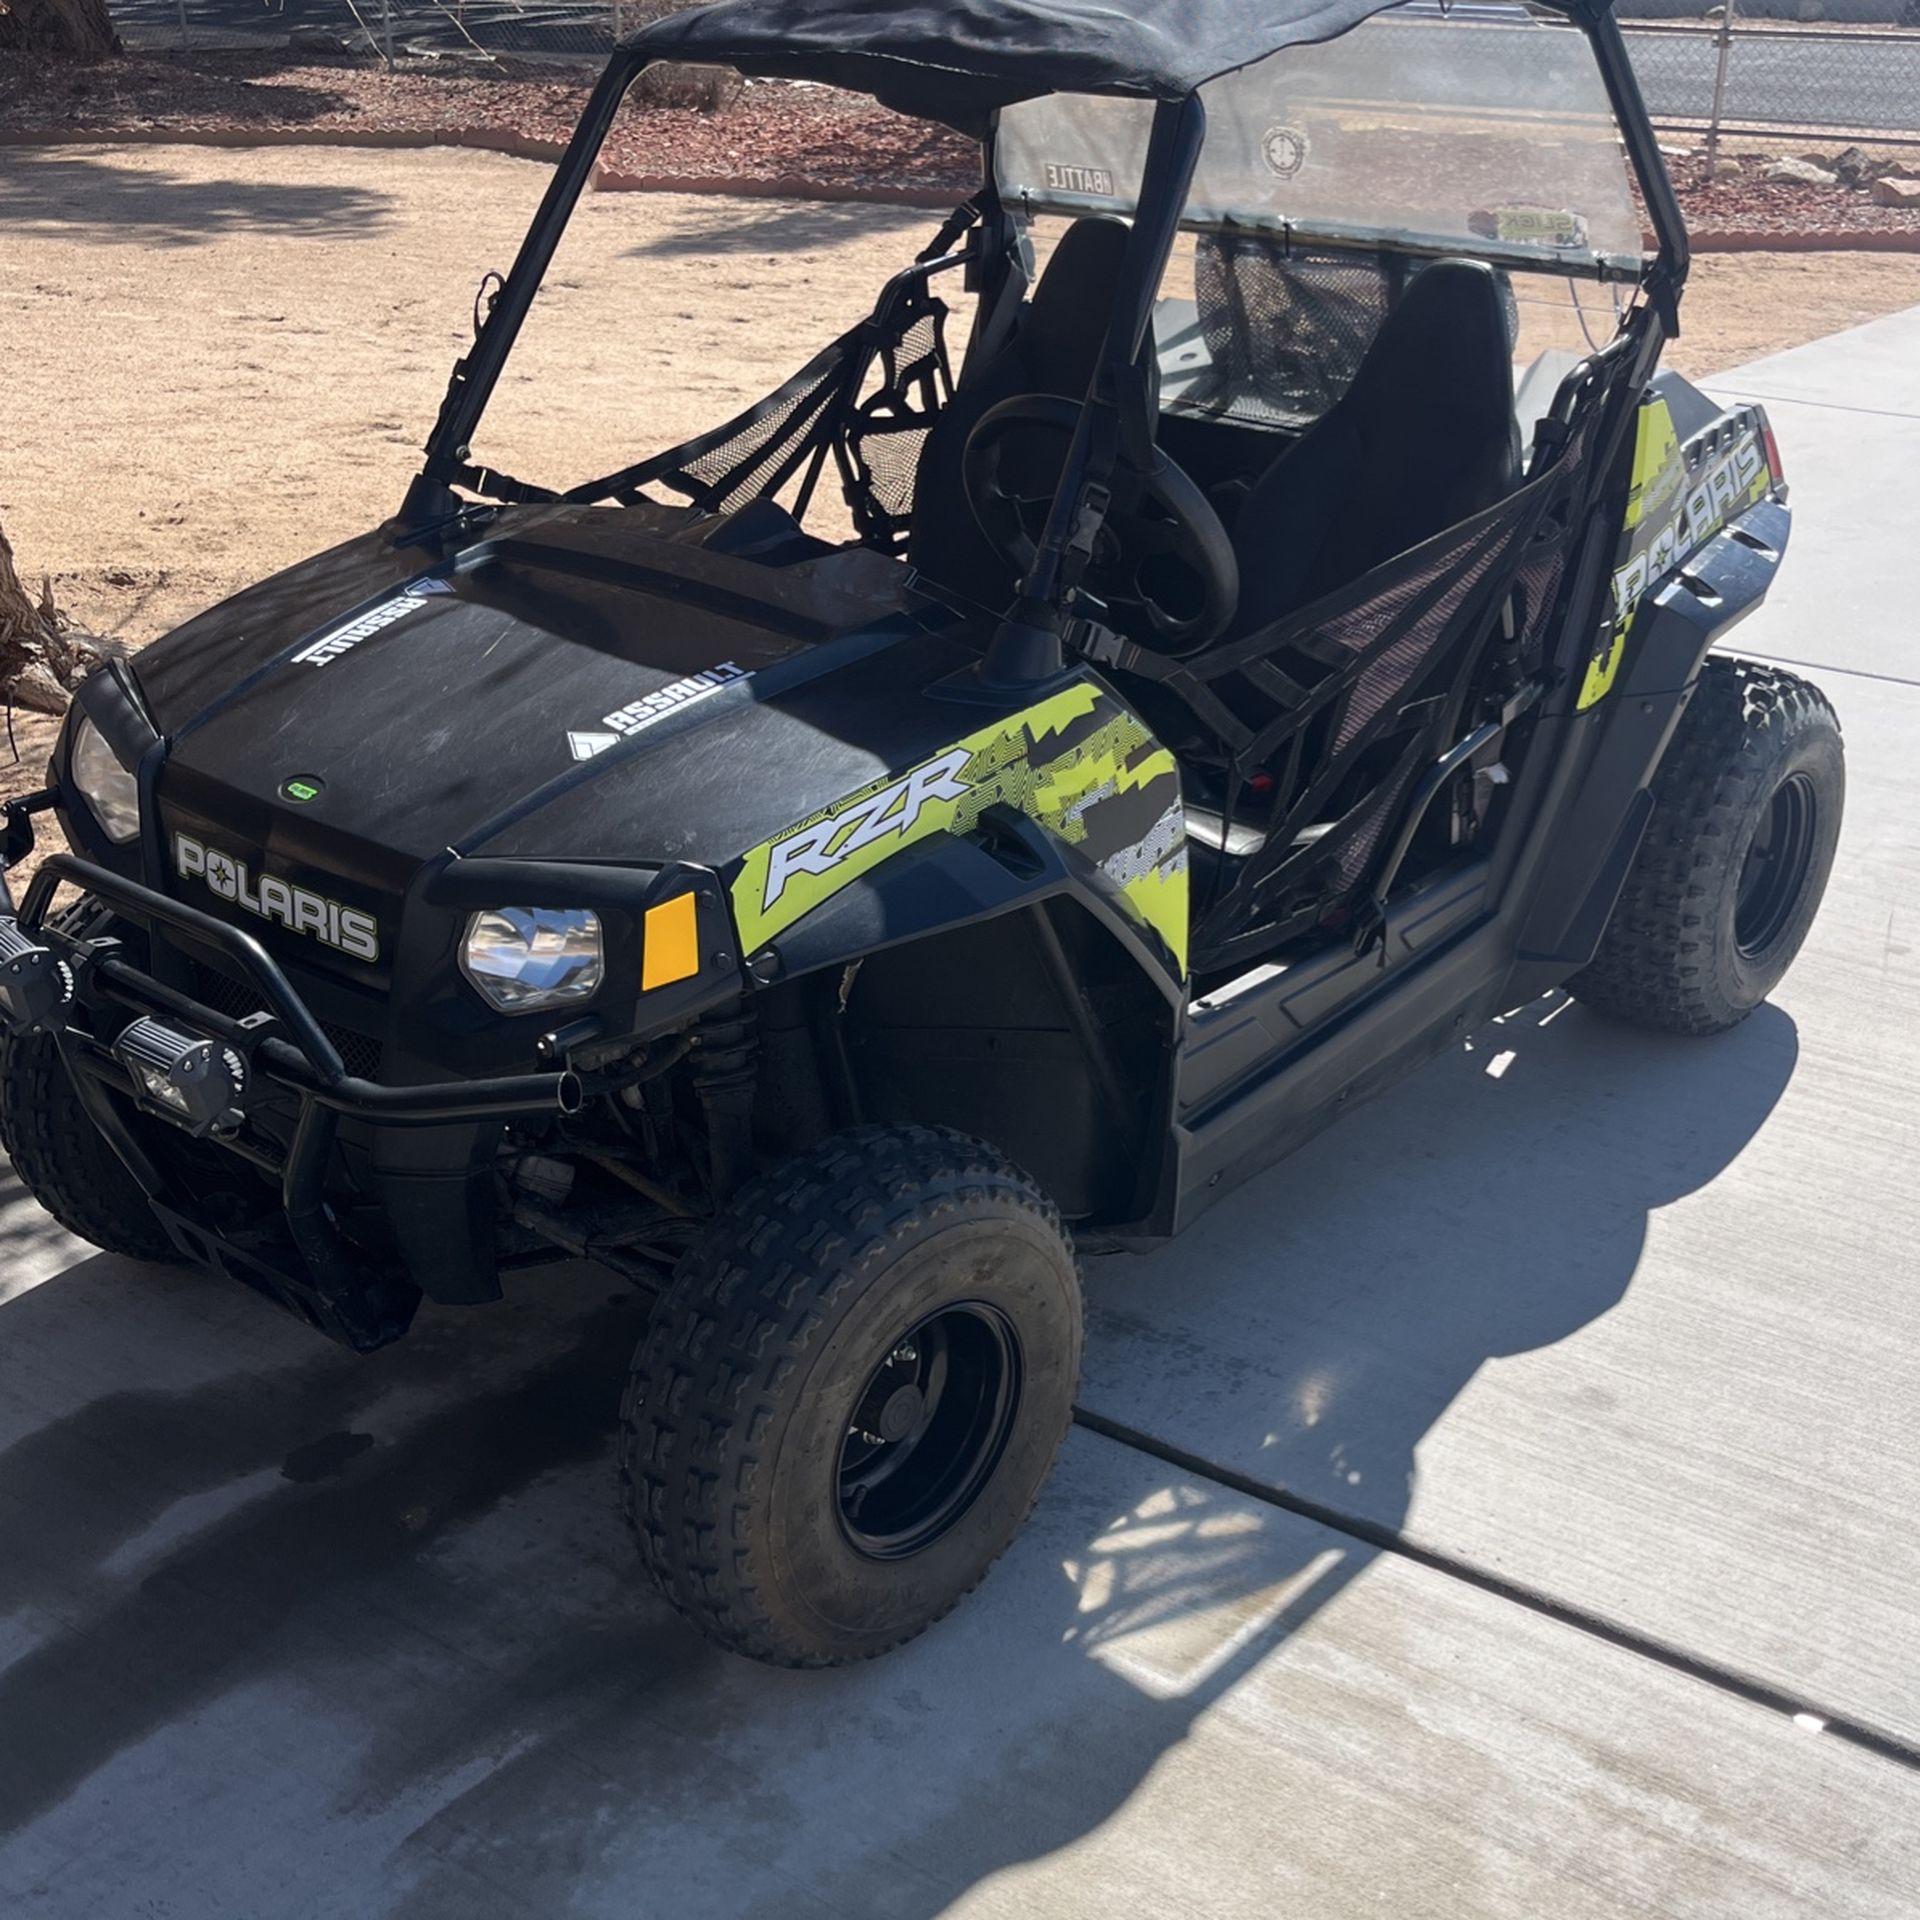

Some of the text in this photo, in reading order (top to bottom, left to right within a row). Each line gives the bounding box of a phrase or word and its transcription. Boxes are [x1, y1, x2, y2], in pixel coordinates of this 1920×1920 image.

[1614, 443, 1763, 616] POLARIS
[305, 597, 428, 667] ASSAULT
[602, 661, 744, 731] ASSAULT
[176, 832, 378, 961] POLARIS
[761, 748, 975, 916] RZR
